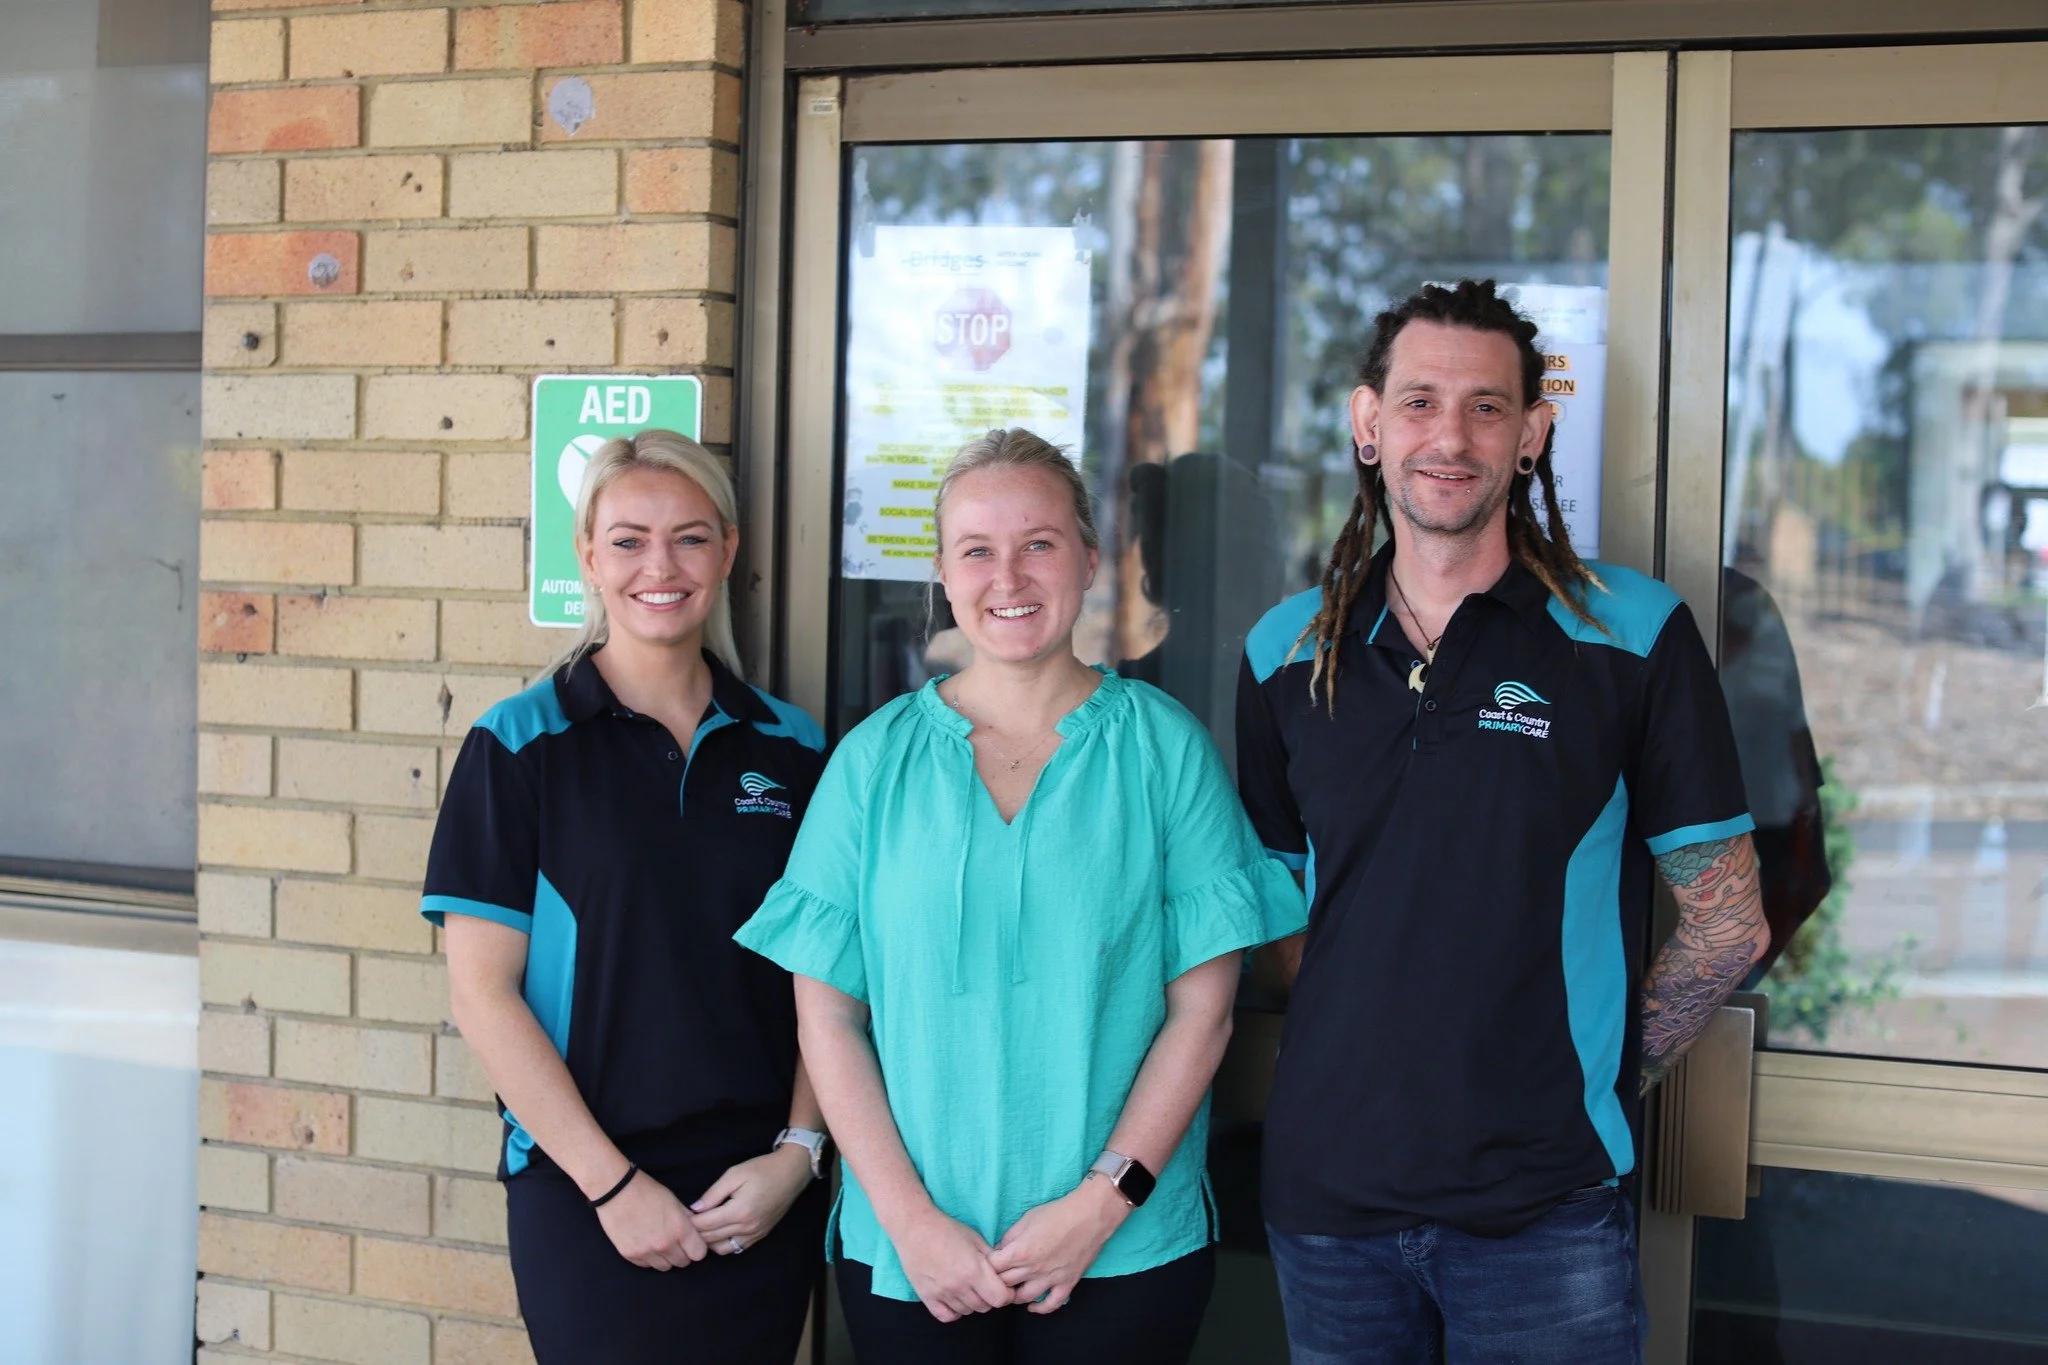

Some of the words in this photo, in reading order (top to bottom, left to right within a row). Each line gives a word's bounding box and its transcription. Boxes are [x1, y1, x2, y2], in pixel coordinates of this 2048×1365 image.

[909, 249, 985, 271] Bridges
[937, 313, 1009, 346] STOP
[579, 385, 651, 424] AED
[541, 579, 585, 594] AUTOM
[1479, 708, 1506, 720] Coast
[1514, 713, 1551, 731] Country
